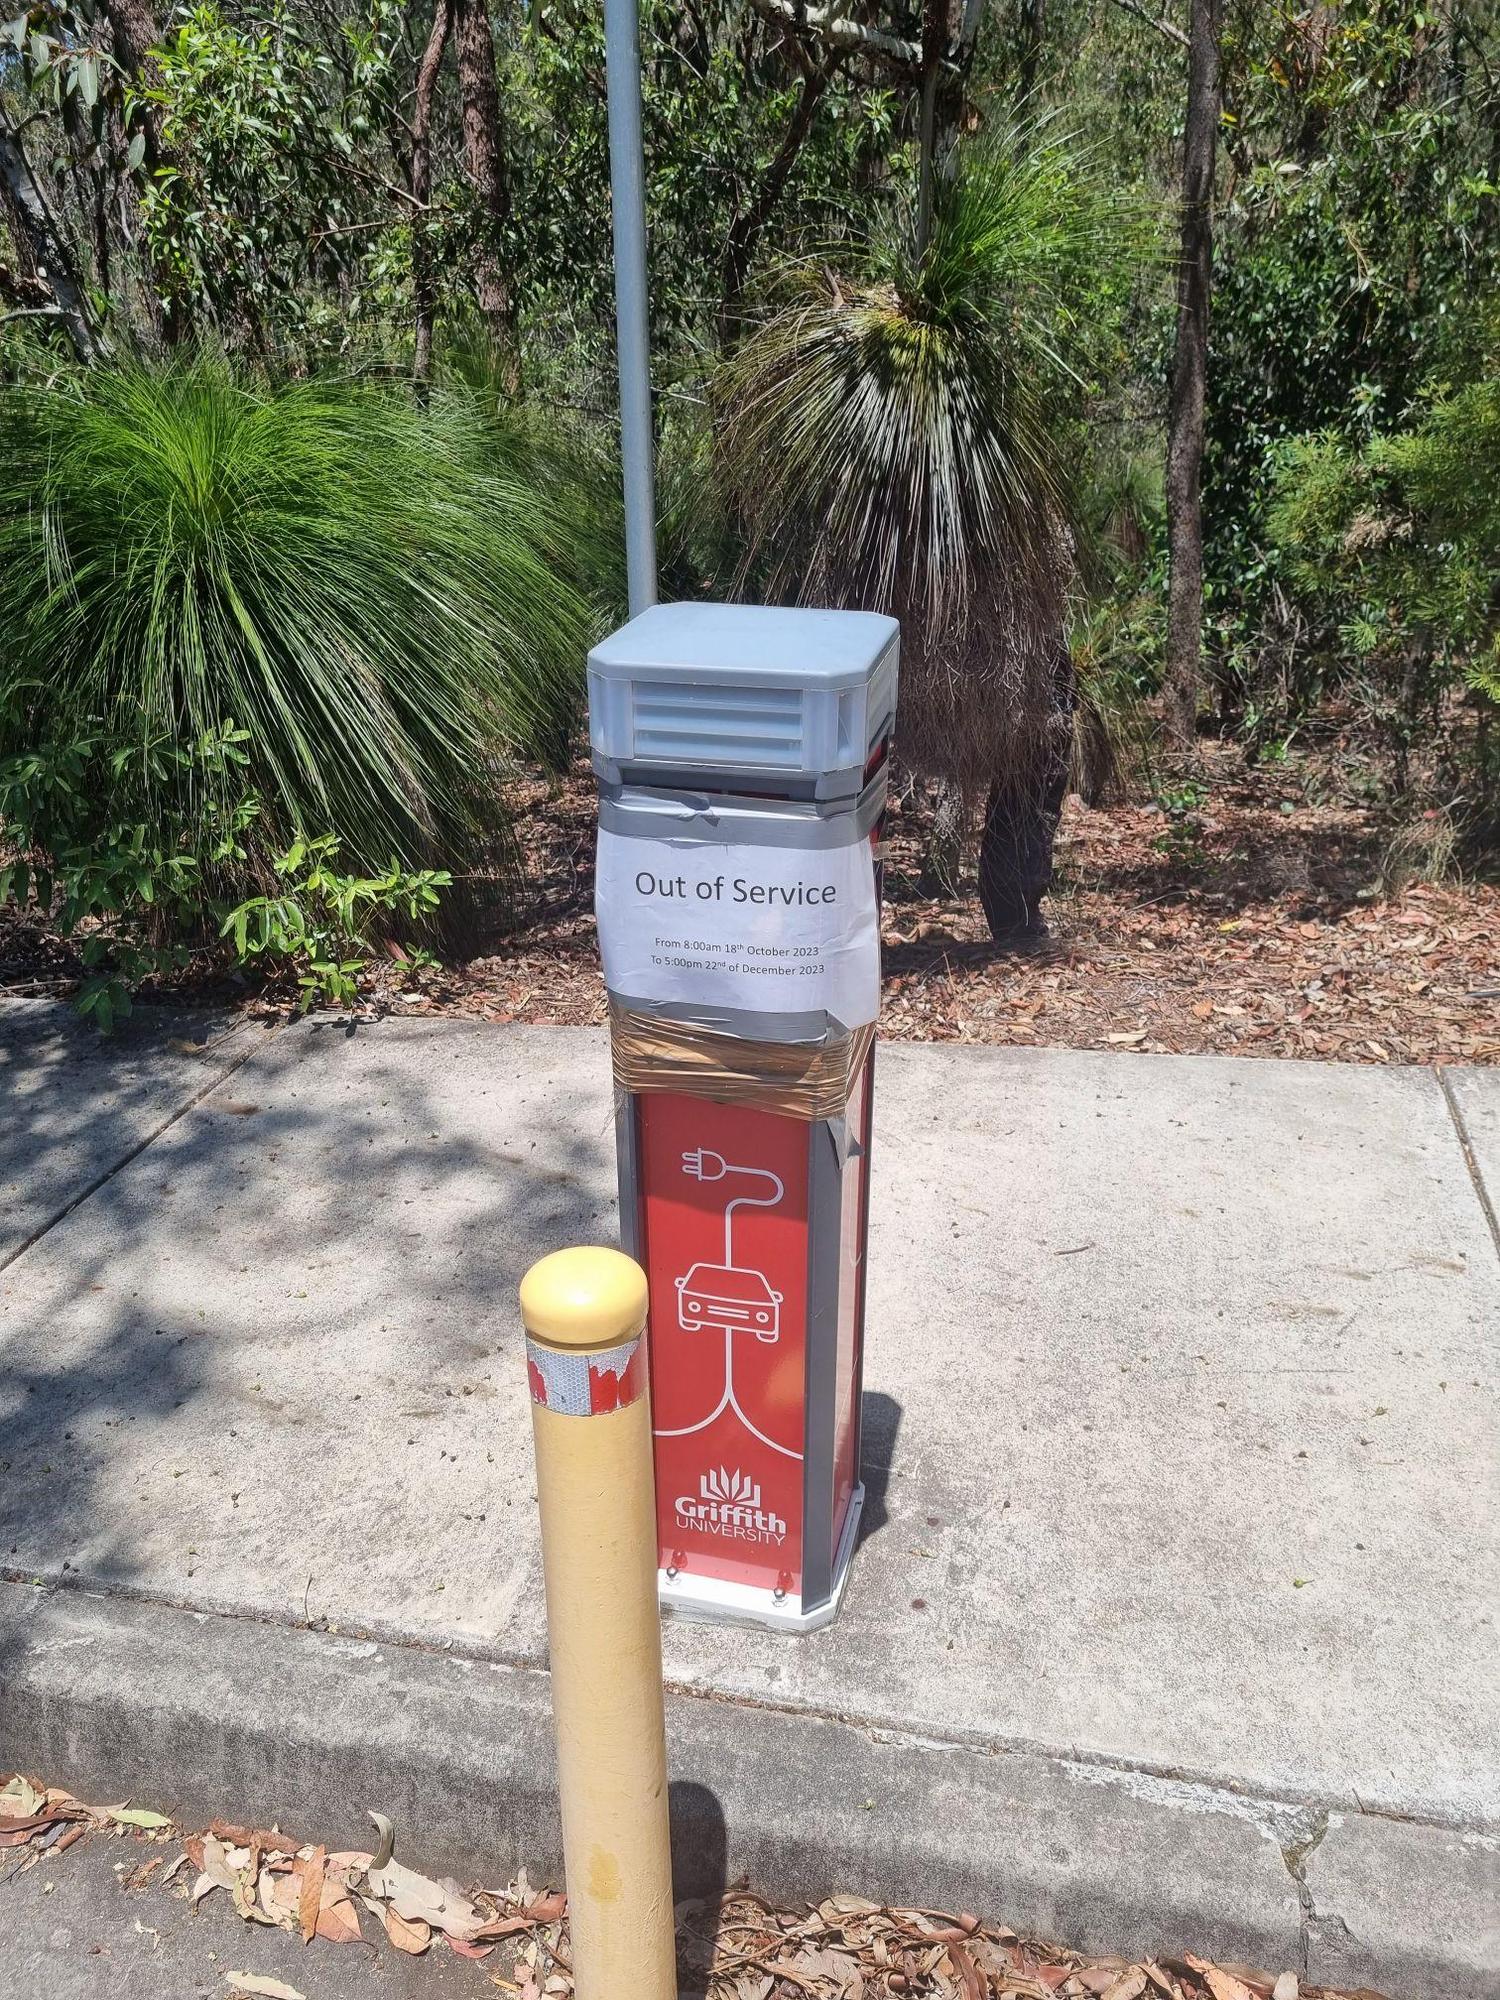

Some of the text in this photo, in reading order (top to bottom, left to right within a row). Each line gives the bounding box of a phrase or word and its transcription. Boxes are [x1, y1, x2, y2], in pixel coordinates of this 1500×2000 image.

[635, 871, 837, 905] Out of Service
[655, 937, 819, 957] From 8:00am 18th October 2023
[651, 955, 825, 976] To 5:00pm 22nd of December 2023
[675, 1496, 787, 1534] Griffith
[676, 1515, 786, 1547] UNIVERSITY
